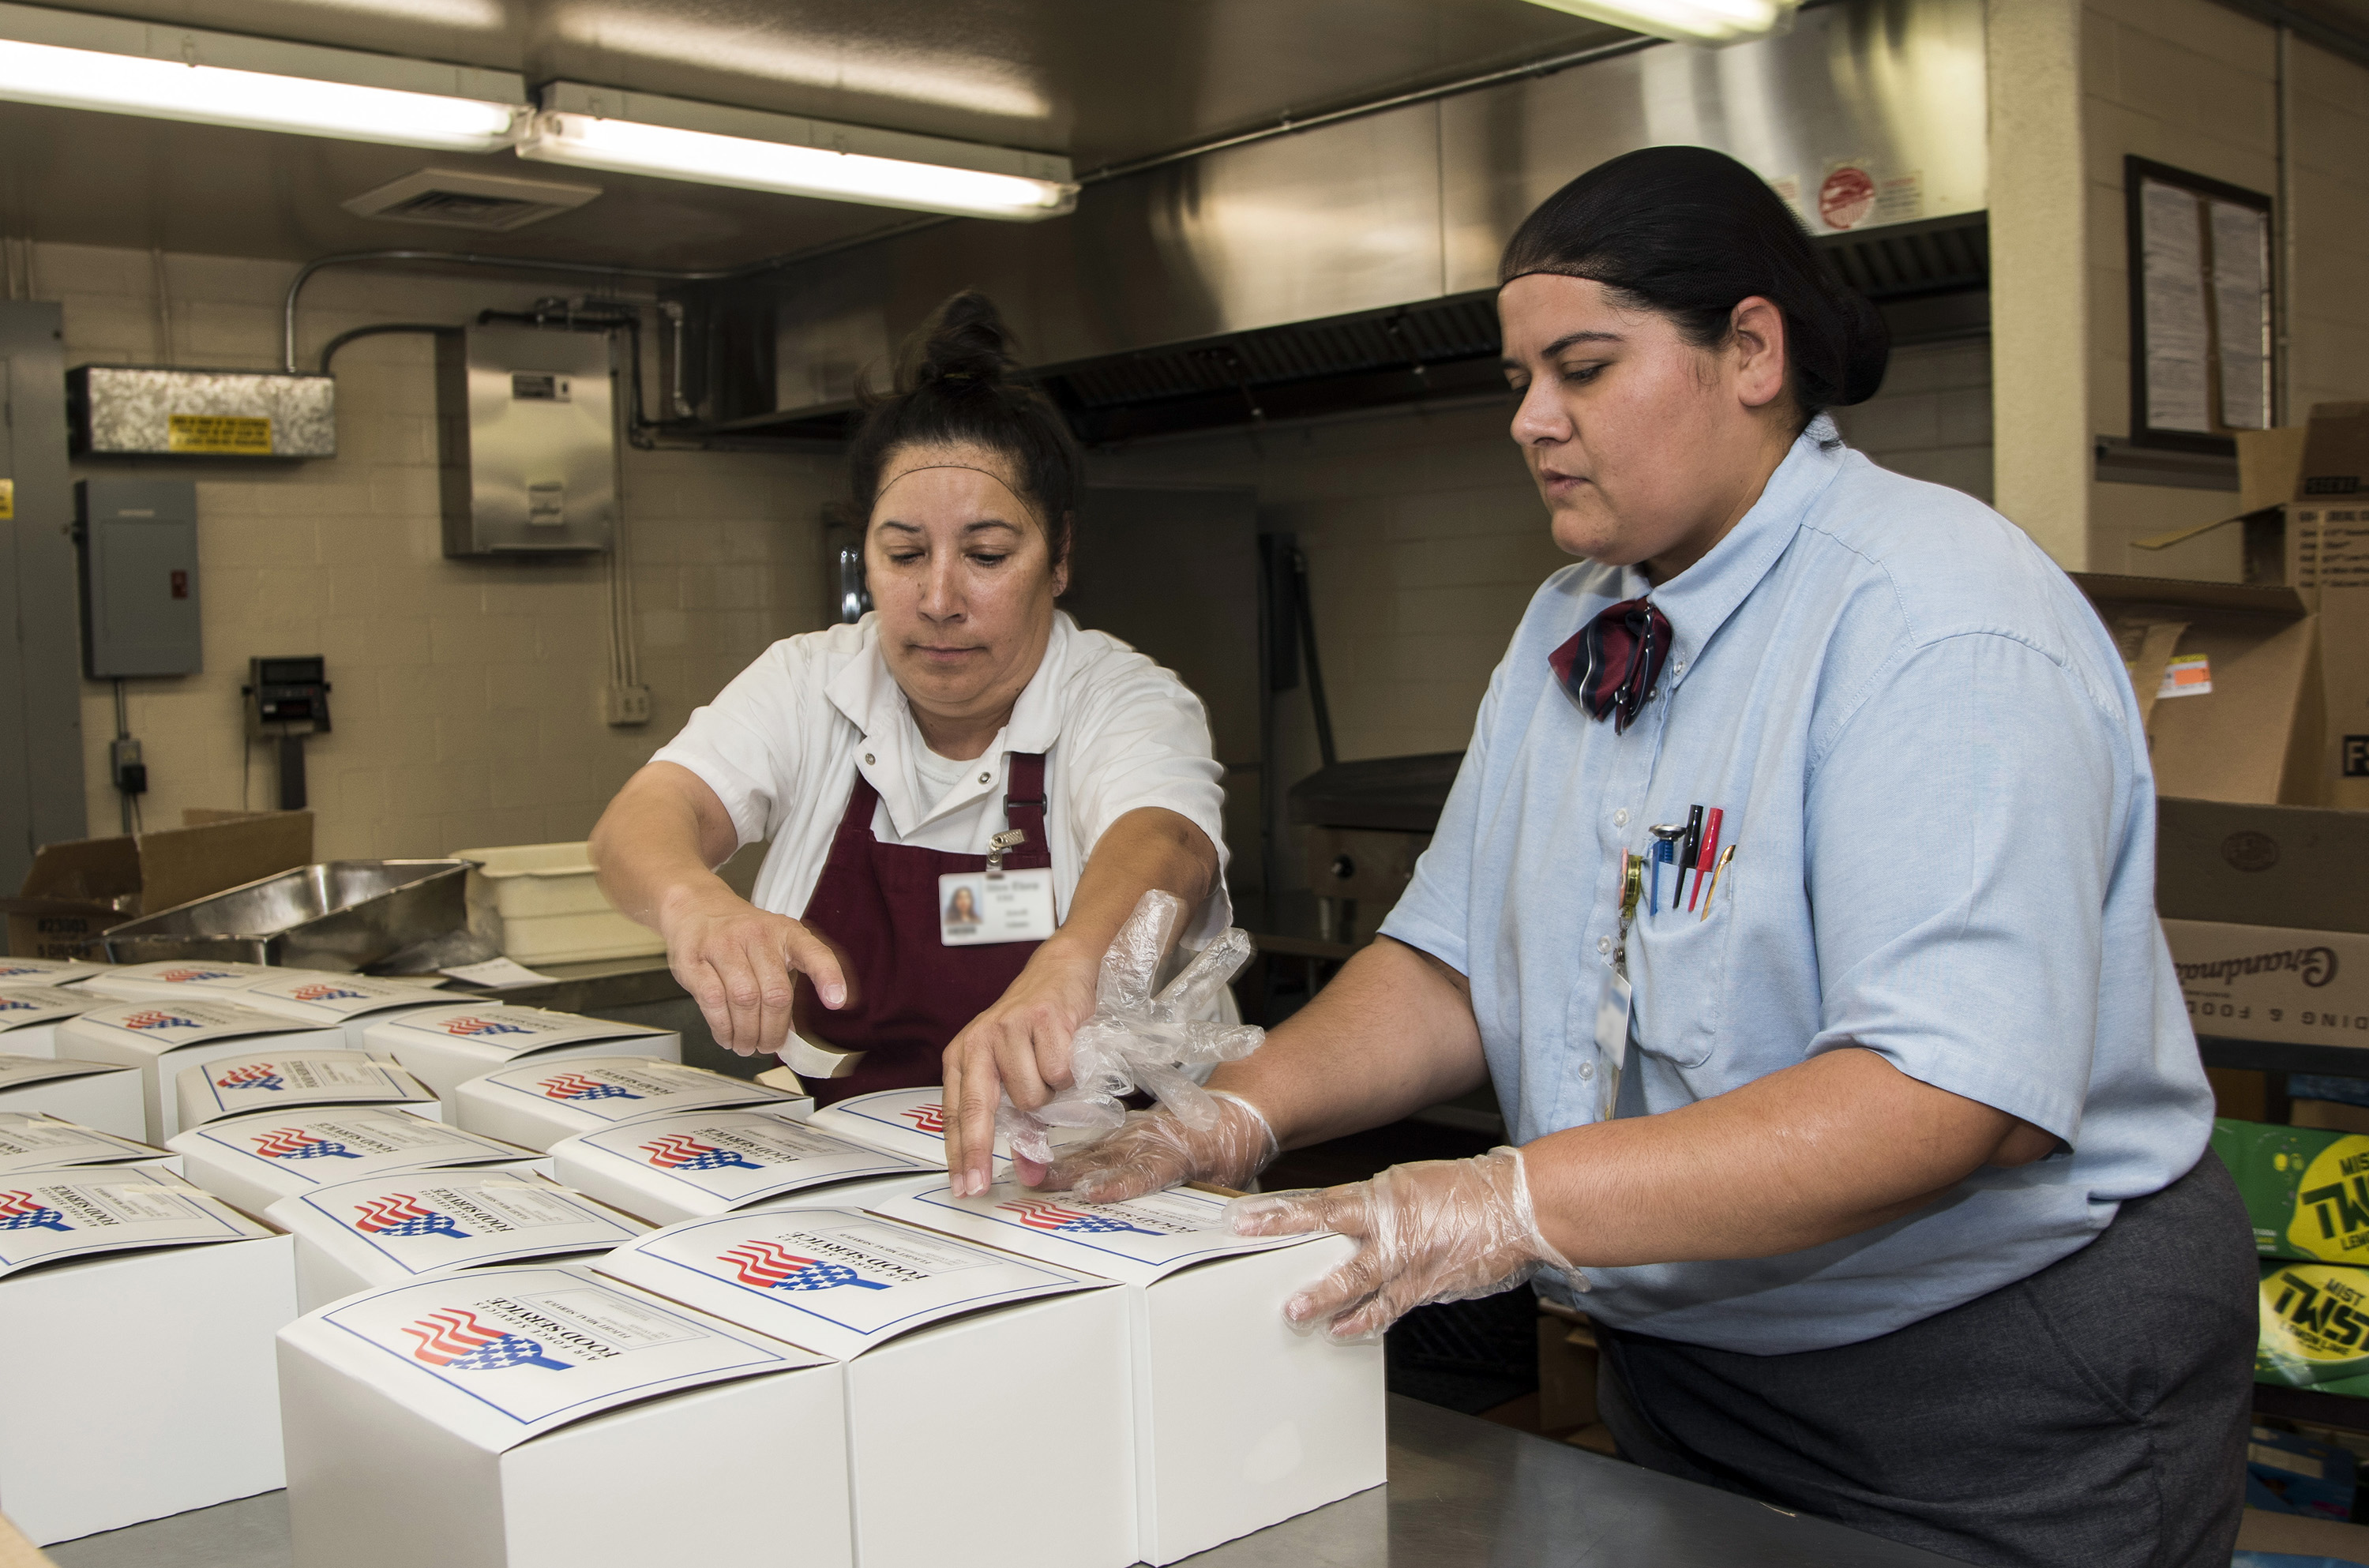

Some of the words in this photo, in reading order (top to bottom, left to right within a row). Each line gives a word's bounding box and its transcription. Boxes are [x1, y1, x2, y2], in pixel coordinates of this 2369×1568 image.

[2269, 1008, 2283, 1022] &
[700, 1127, 760, 1147] SERVICE
[755, 1147, 800, 1162] FOOD
[36, 1187, 67, 1206] SERVICES
[49, 1184, 94, 1208] SERVICE
[419, 1191, 455, 1210] SERVICES
[430, 1188, 482, 1212] SERVICE
[63, 1206, 88, 1219] FORCE
[84, 1208, 120, 1226] FOOD
[452, 1210, 480, 1225] FORCE
[474, 1213, 515, 1232] FOOD
[478, 1225, 494, 1233] AIR
[1136, 1217, 1199, 1232] FOOD
[776, 1236, 835, 1256] SERVICES
[786, 1231, 870, 1259] SERVICE
[839, 1257, 884, 1273] FORCE
[867, 1259, 931, 1279] FOOD
[886, 1273, 913, 1282] AIR
[2325, 1277, 2366, 1306] MIST
[473, 1302, 530, 1328] SERVICES
[486, 1297, 565, 1331] SERVICE
[543, 1300, 575, 1314] SERVICE
[576, 1314, 598, 1325] MEAL
[531, 1330, 573, 1348] FORCE
[597, 1324, 631, 1338] FLIGHT
[560, 1331, 623, 1357] FOOD
[574, 1349, 599, 1360] AIR
